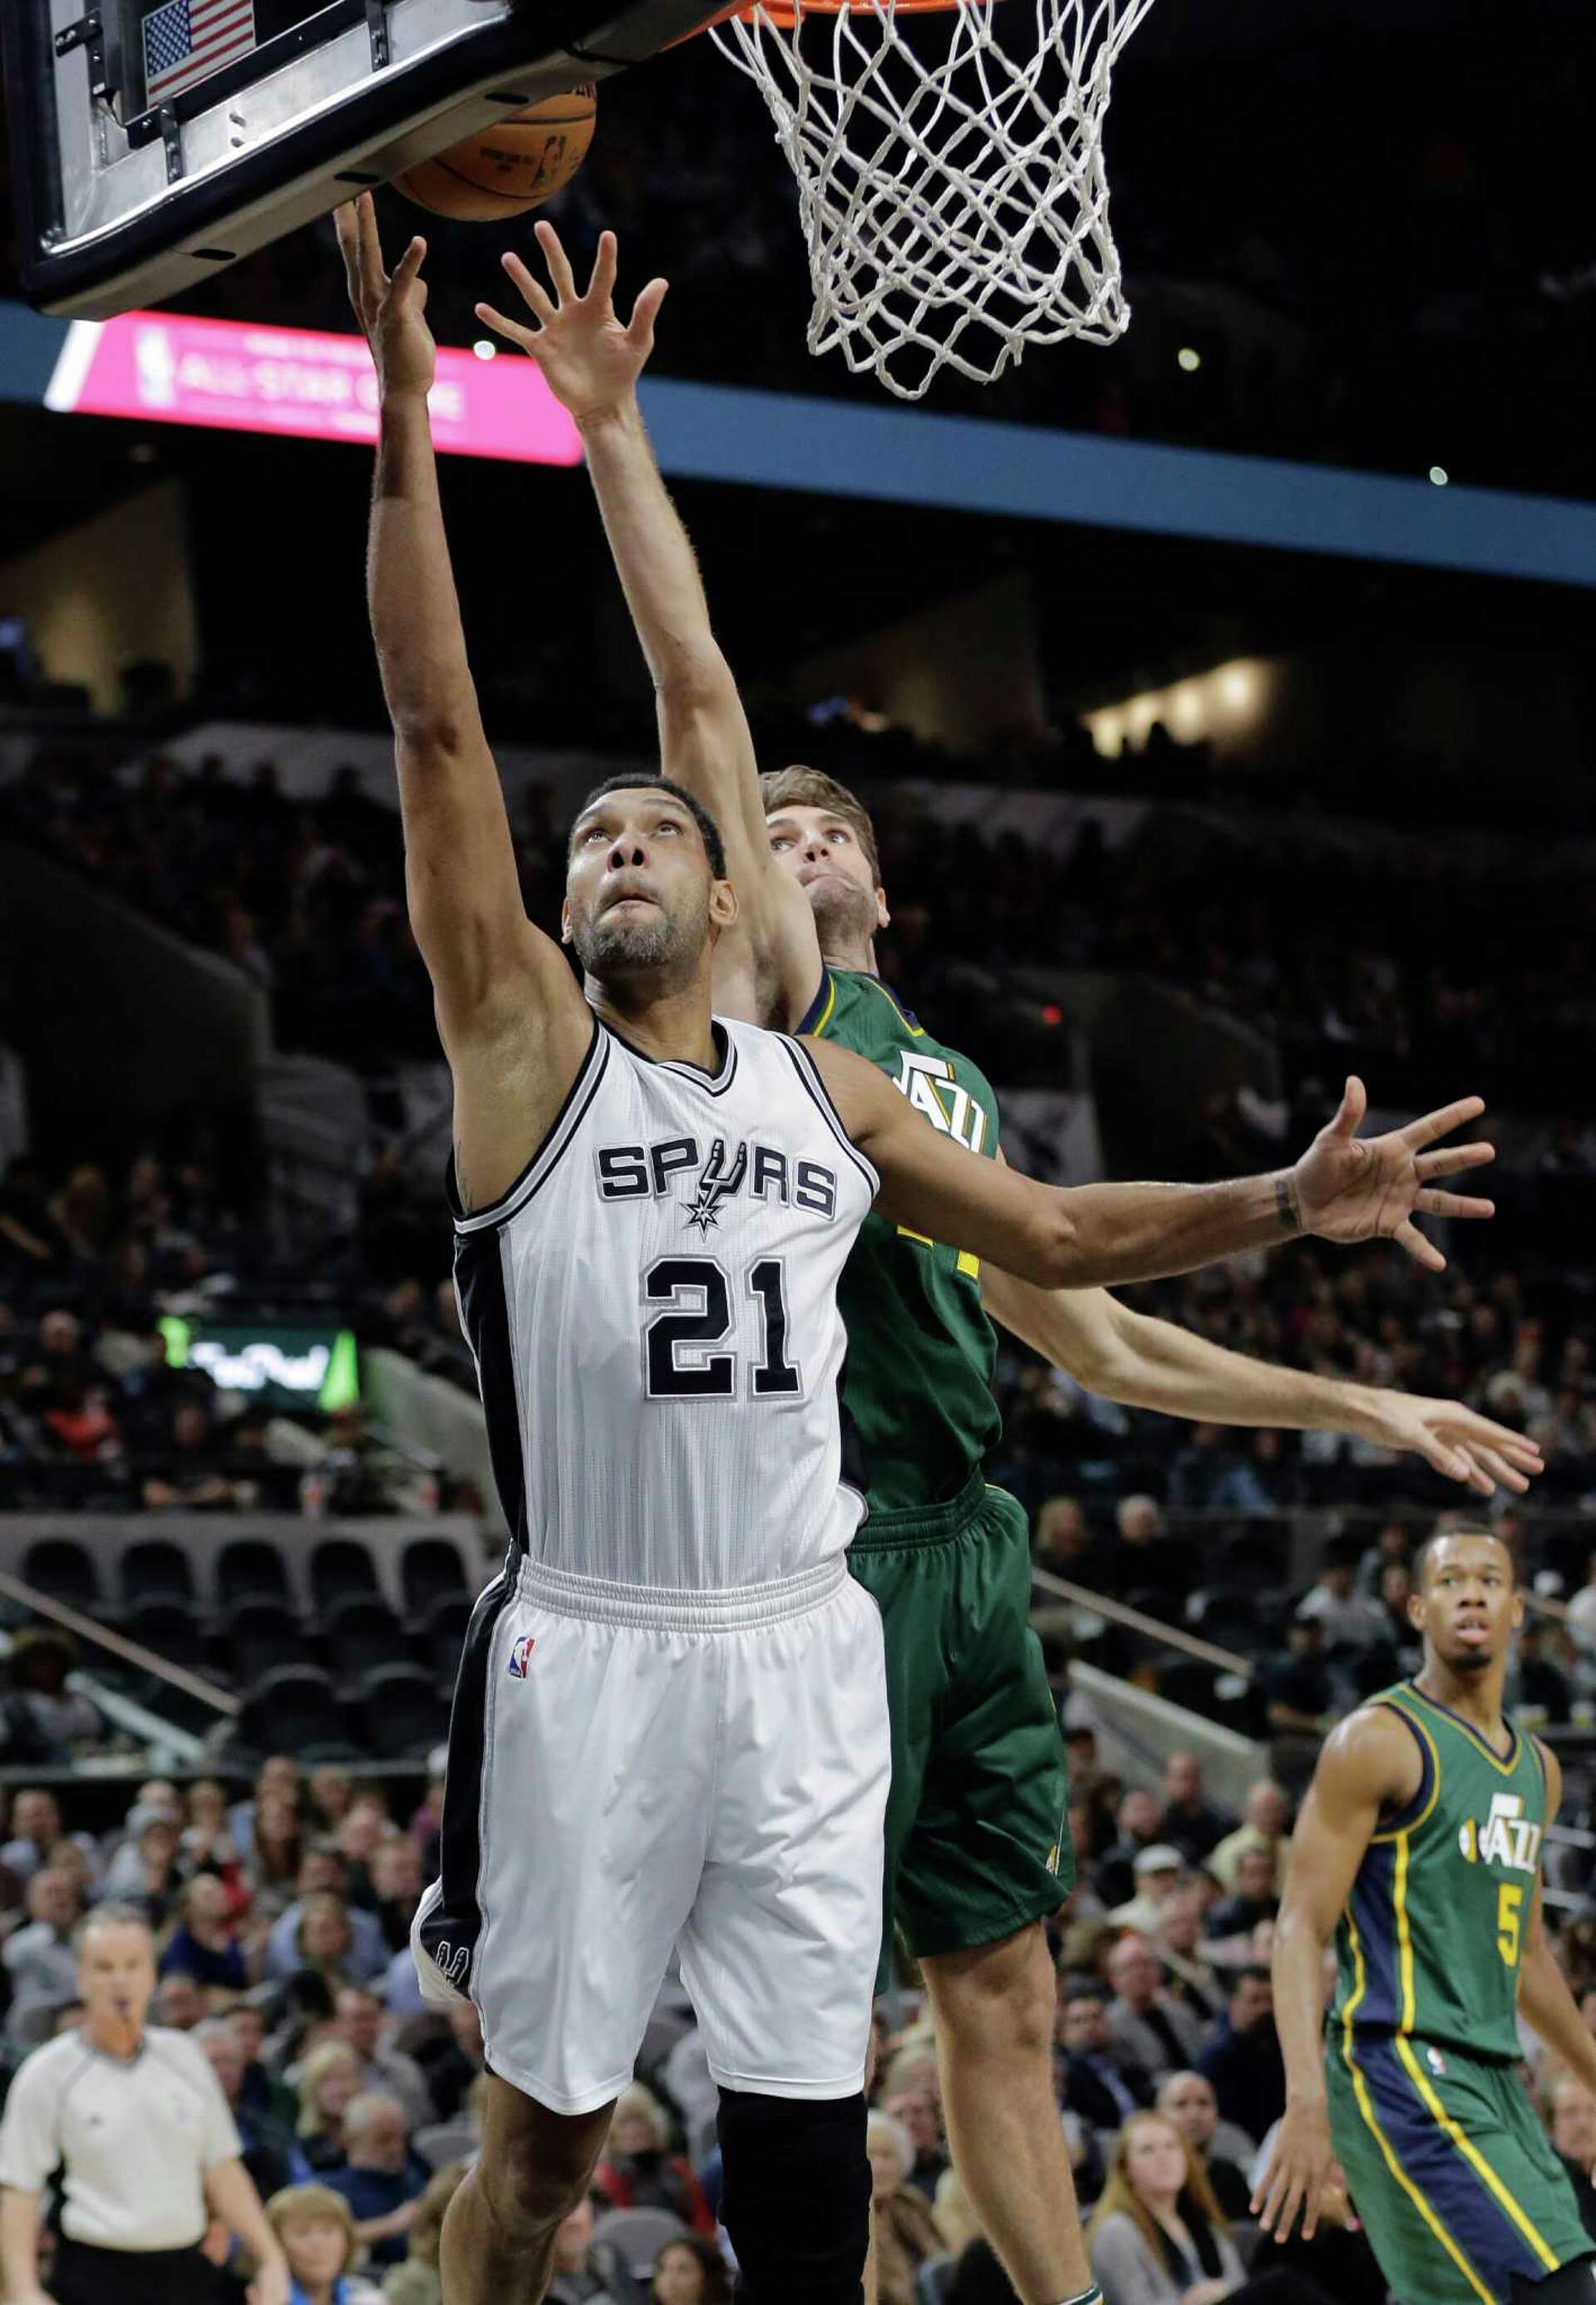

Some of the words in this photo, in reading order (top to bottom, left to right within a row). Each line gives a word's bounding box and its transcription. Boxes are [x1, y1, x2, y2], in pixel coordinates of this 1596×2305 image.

[594, 1136, 836, 1223] SPURS
[639, 1253, 804, 1402] 21
[1476, 1791, 1542, 1875] JAZZ
[1496, 1882, 1523, 1968] 5
